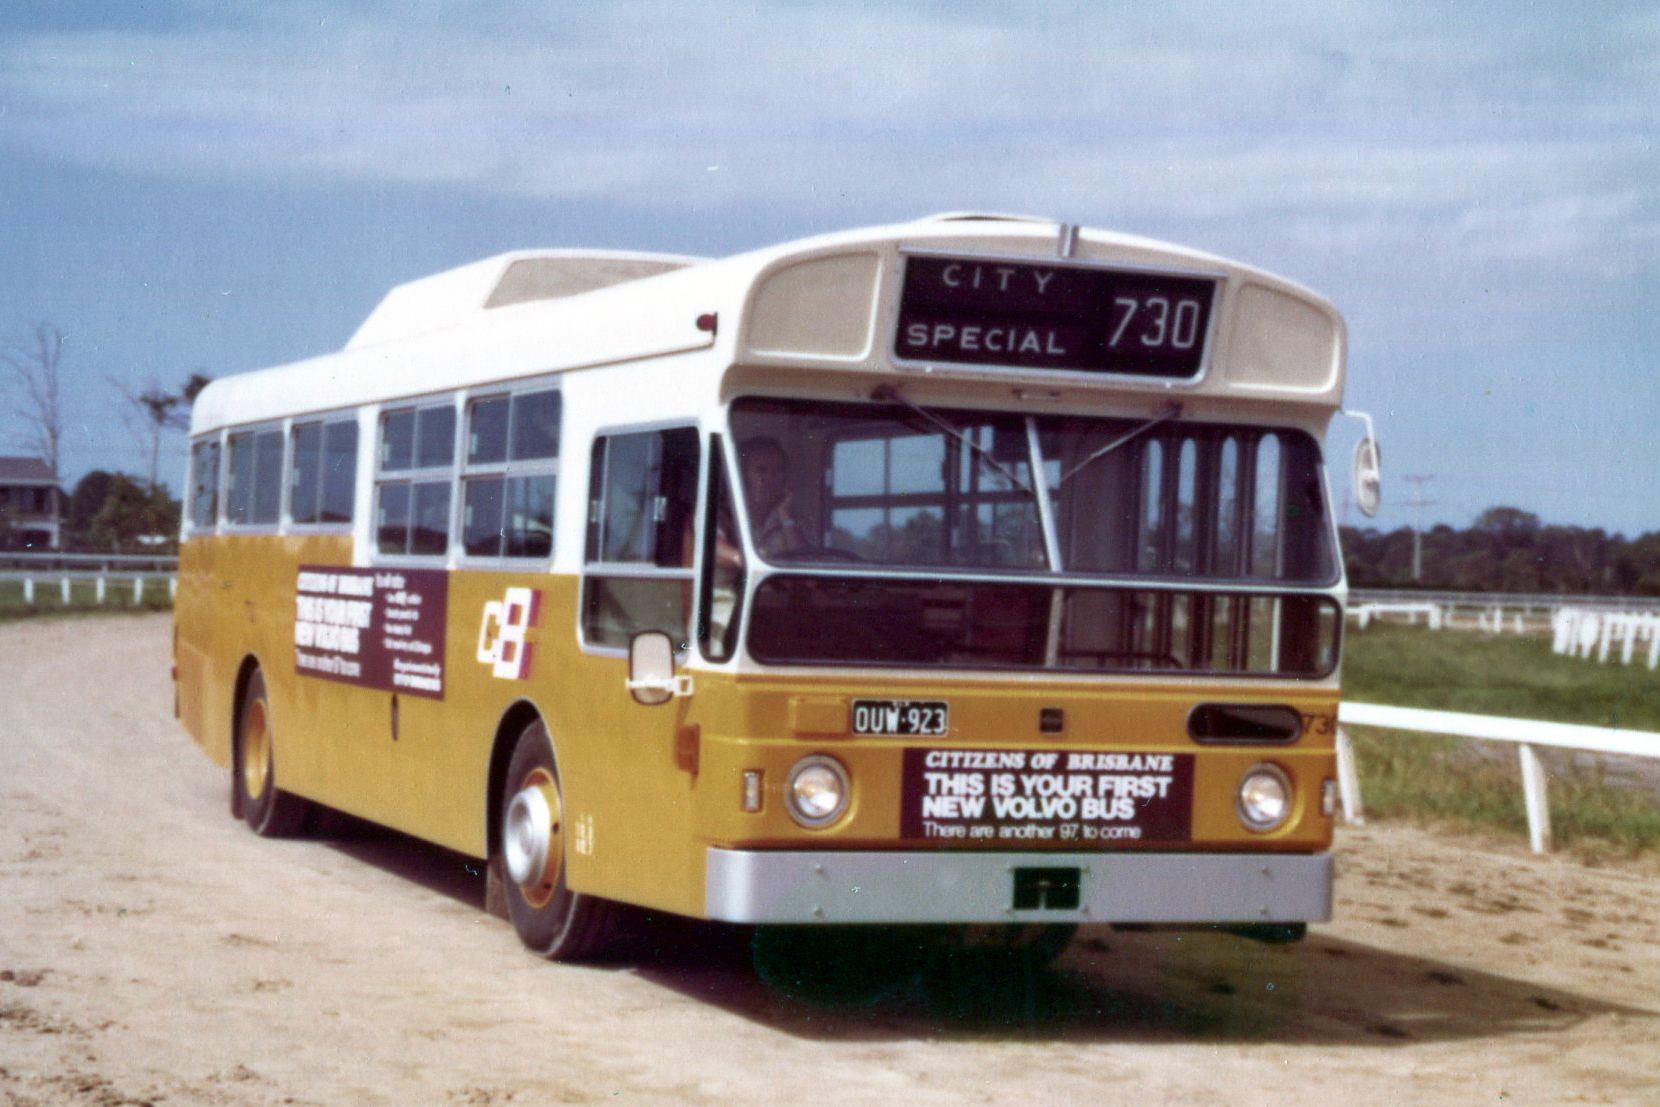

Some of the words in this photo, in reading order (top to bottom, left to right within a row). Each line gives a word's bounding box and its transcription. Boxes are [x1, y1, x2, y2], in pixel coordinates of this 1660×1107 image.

[943, 264, 1053, 293] CITY
[1108, 296, 1199, 348] 730
[907, 324, 1065, 354] SPECIAL
[925, 751, 1025, 769] CITIZENS
[1030, 753, 1058, 770] OF
[1067, 753, 1174, 772] BRISBANE
[924, 772, 985, 795] THIS
[991, 774, 1015, 796] IS
[1021, 775, 1093, 797] YOUR
[1098, 776, 1173, 798] FIRST
[923, 796, 985, 818] NEW
[993, 797, 1077, 819] VOLVO
[1081, 798, 1135, 820] BUS
[923, 821, 966, 838] There
[969, 825, 994, 838] are
[998, 823, 1054, 839] another
[1060, 824, 1078, 839] 97
[1083, 825, 1098, 839] to
[1101, 827, 1141, 839] come
